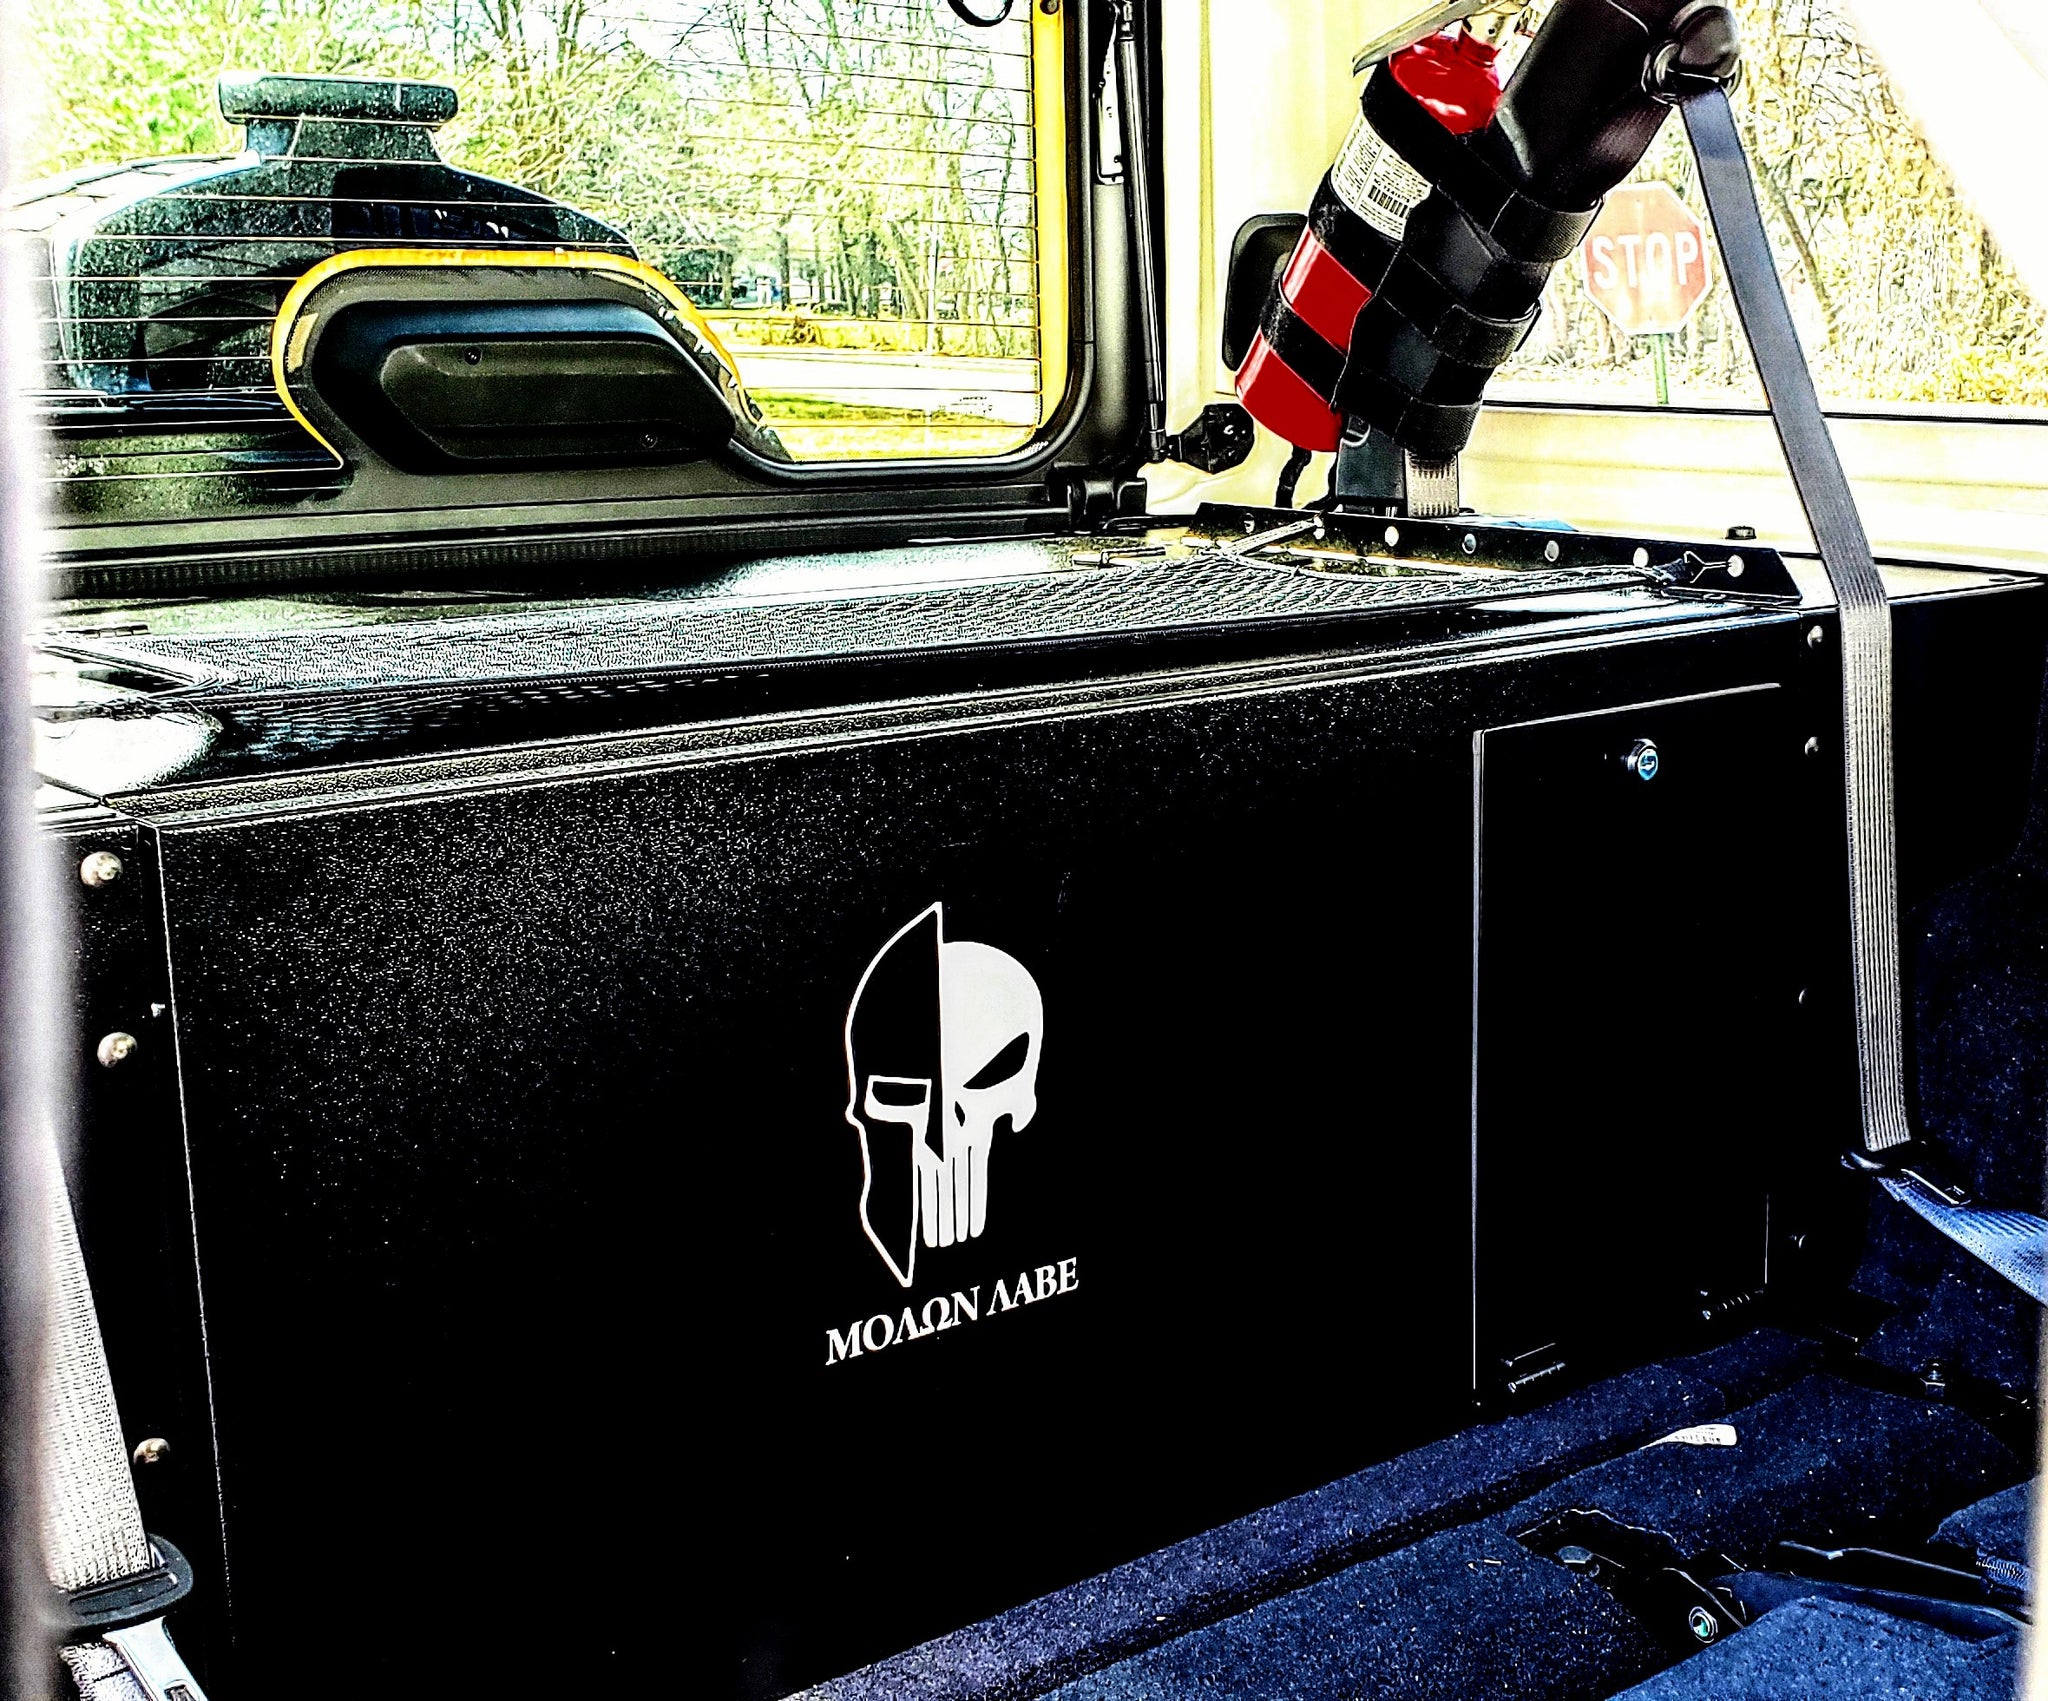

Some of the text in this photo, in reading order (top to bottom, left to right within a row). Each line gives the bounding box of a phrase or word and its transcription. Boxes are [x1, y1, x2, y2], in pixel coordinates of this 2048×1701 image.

[1592, 231, 1699, 290] STOP
[825, 1256, 1080, 1366] ΜΟΛΩΝ ΛΑΒΕ
